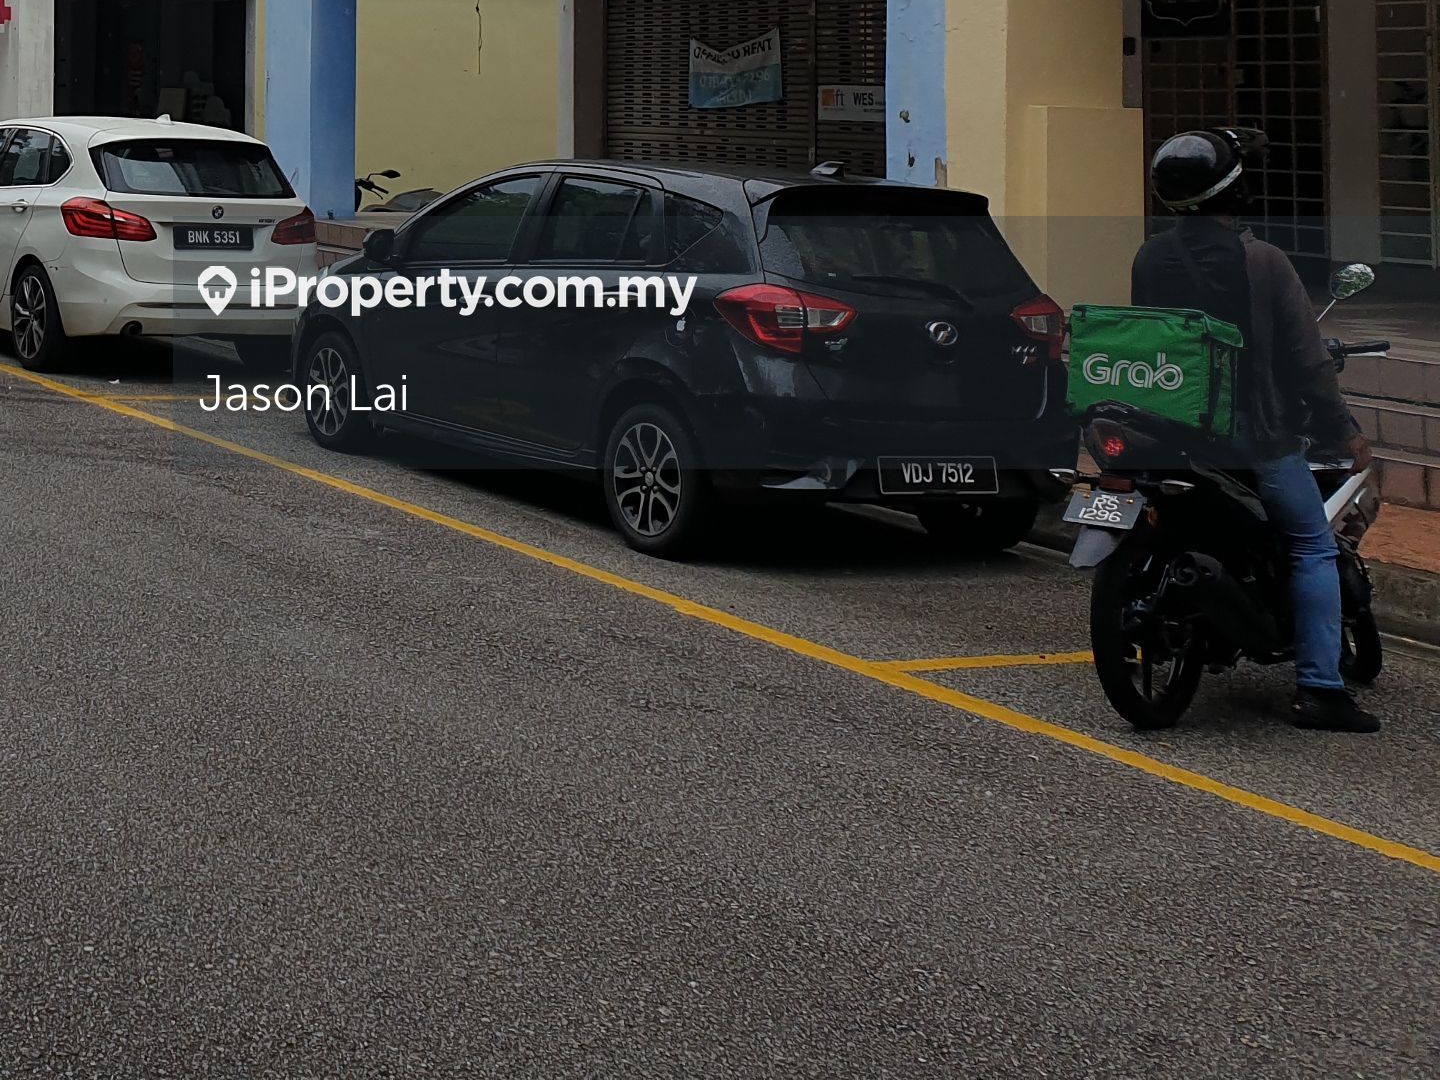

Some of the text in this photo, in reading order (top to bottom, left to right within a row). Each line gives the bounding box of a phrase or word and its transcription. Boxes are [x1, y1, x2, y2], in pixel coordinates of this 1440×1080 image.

[743, 37, 773, 58] RENT
[188, 230, 240, 244] BNK 5351
[1082, 351, 1184, 390] Grab
[901, 463, 975, 484] VDJ 7512
[1092, 496, 1120, 510] RS
[1078, 507, 1122, 522] 1296
